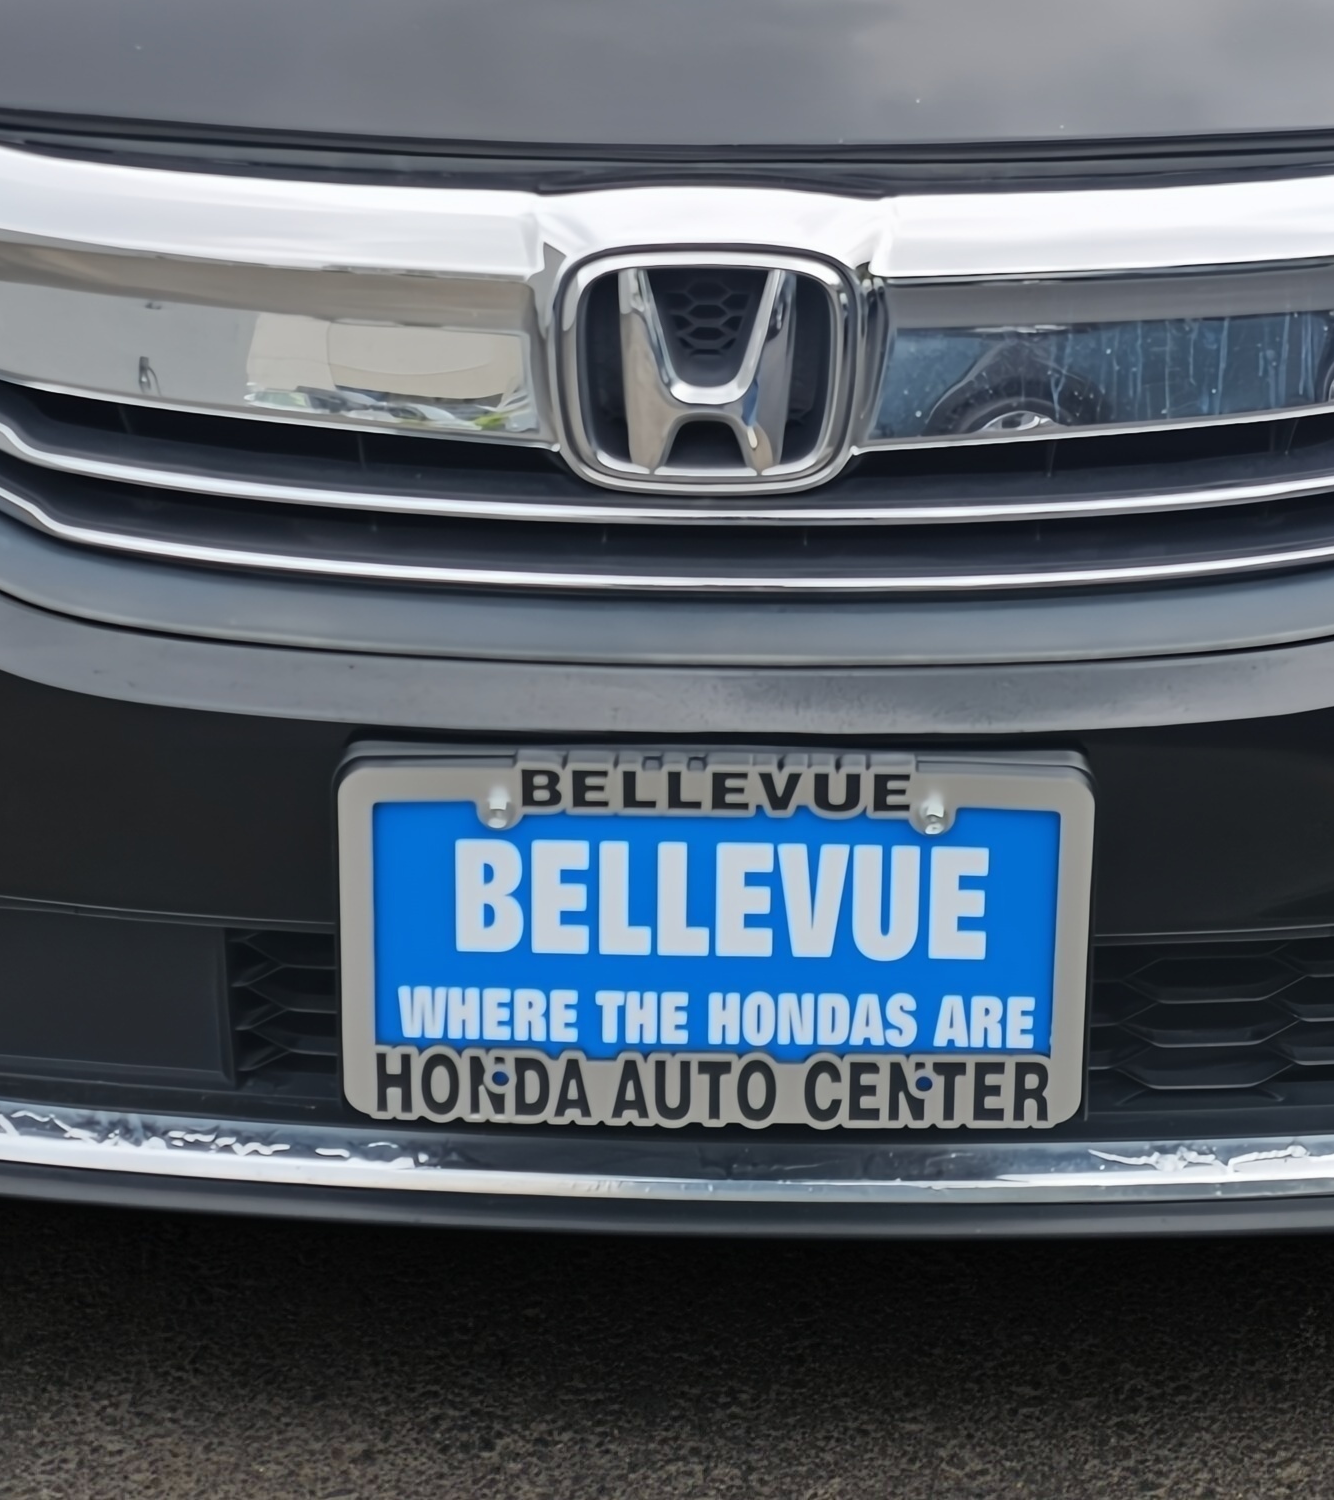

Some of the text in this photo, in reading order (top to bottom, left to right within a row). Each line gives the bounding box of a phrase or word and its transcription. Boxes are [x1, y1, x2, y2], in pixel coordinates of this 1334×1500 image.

[520, 769, 911, 813] BELLEVUE
[454, 838, 990, 962] BELLEVUE
[397, 985, 1036, 1049] WHERE THE HONDAS ARE
[375, 1052, 1049, 1123] HONDA AUTO CENTER
